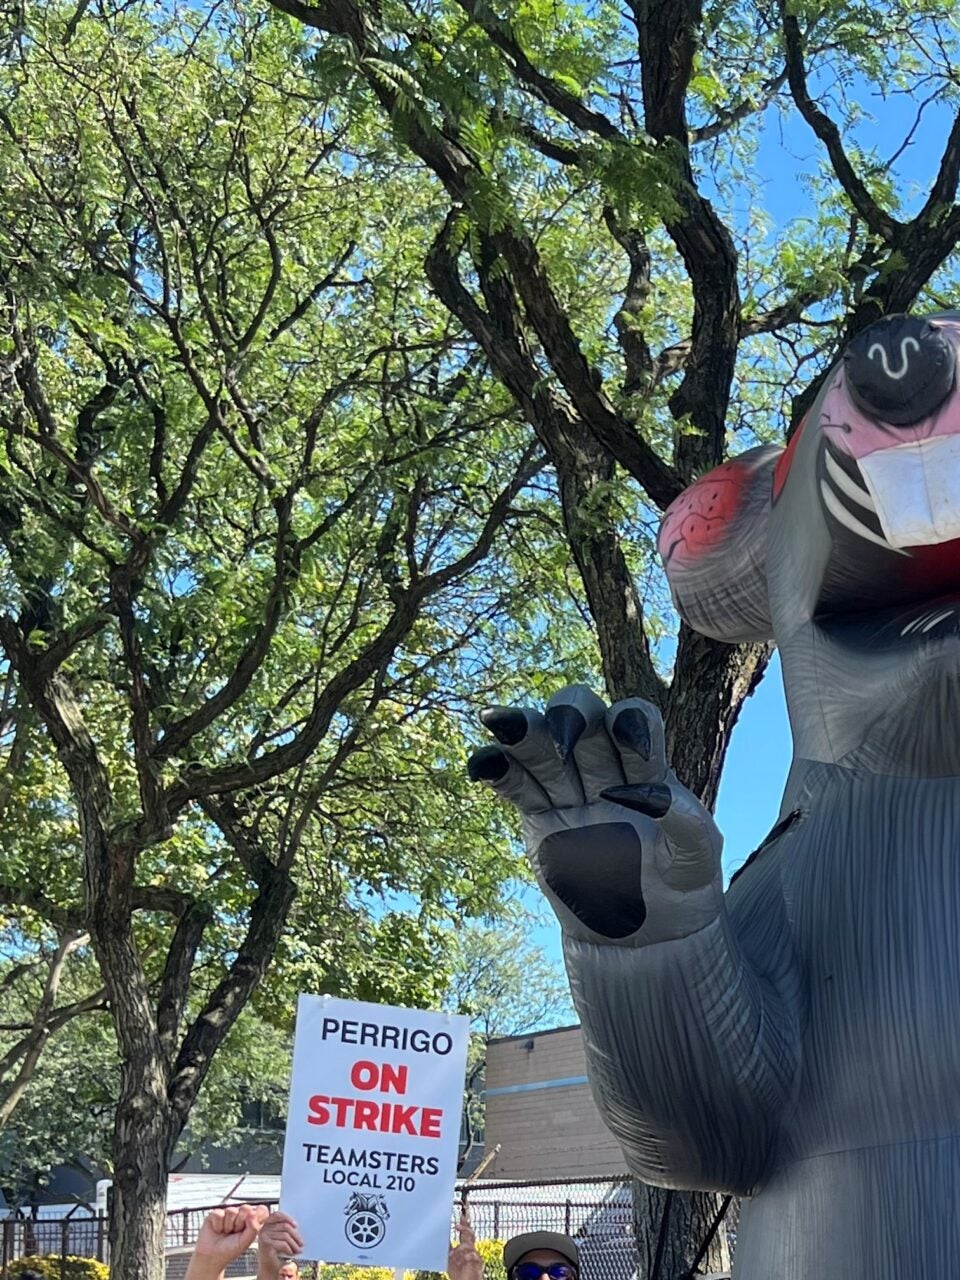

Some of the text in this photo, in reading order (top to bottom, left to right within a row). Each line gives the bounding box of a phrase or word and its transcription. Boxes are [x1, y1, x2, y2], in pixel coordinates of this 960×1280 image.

[321, 1017, 453, 1056] PERRIGO
[350, 1060, 408, 1095] ON
[307, 1094, 443, 1139] STRIKE
[302, 1143, 440, 1176] TEAMSTERS
[323, 1168, 416, 1193] LOCAL 210
